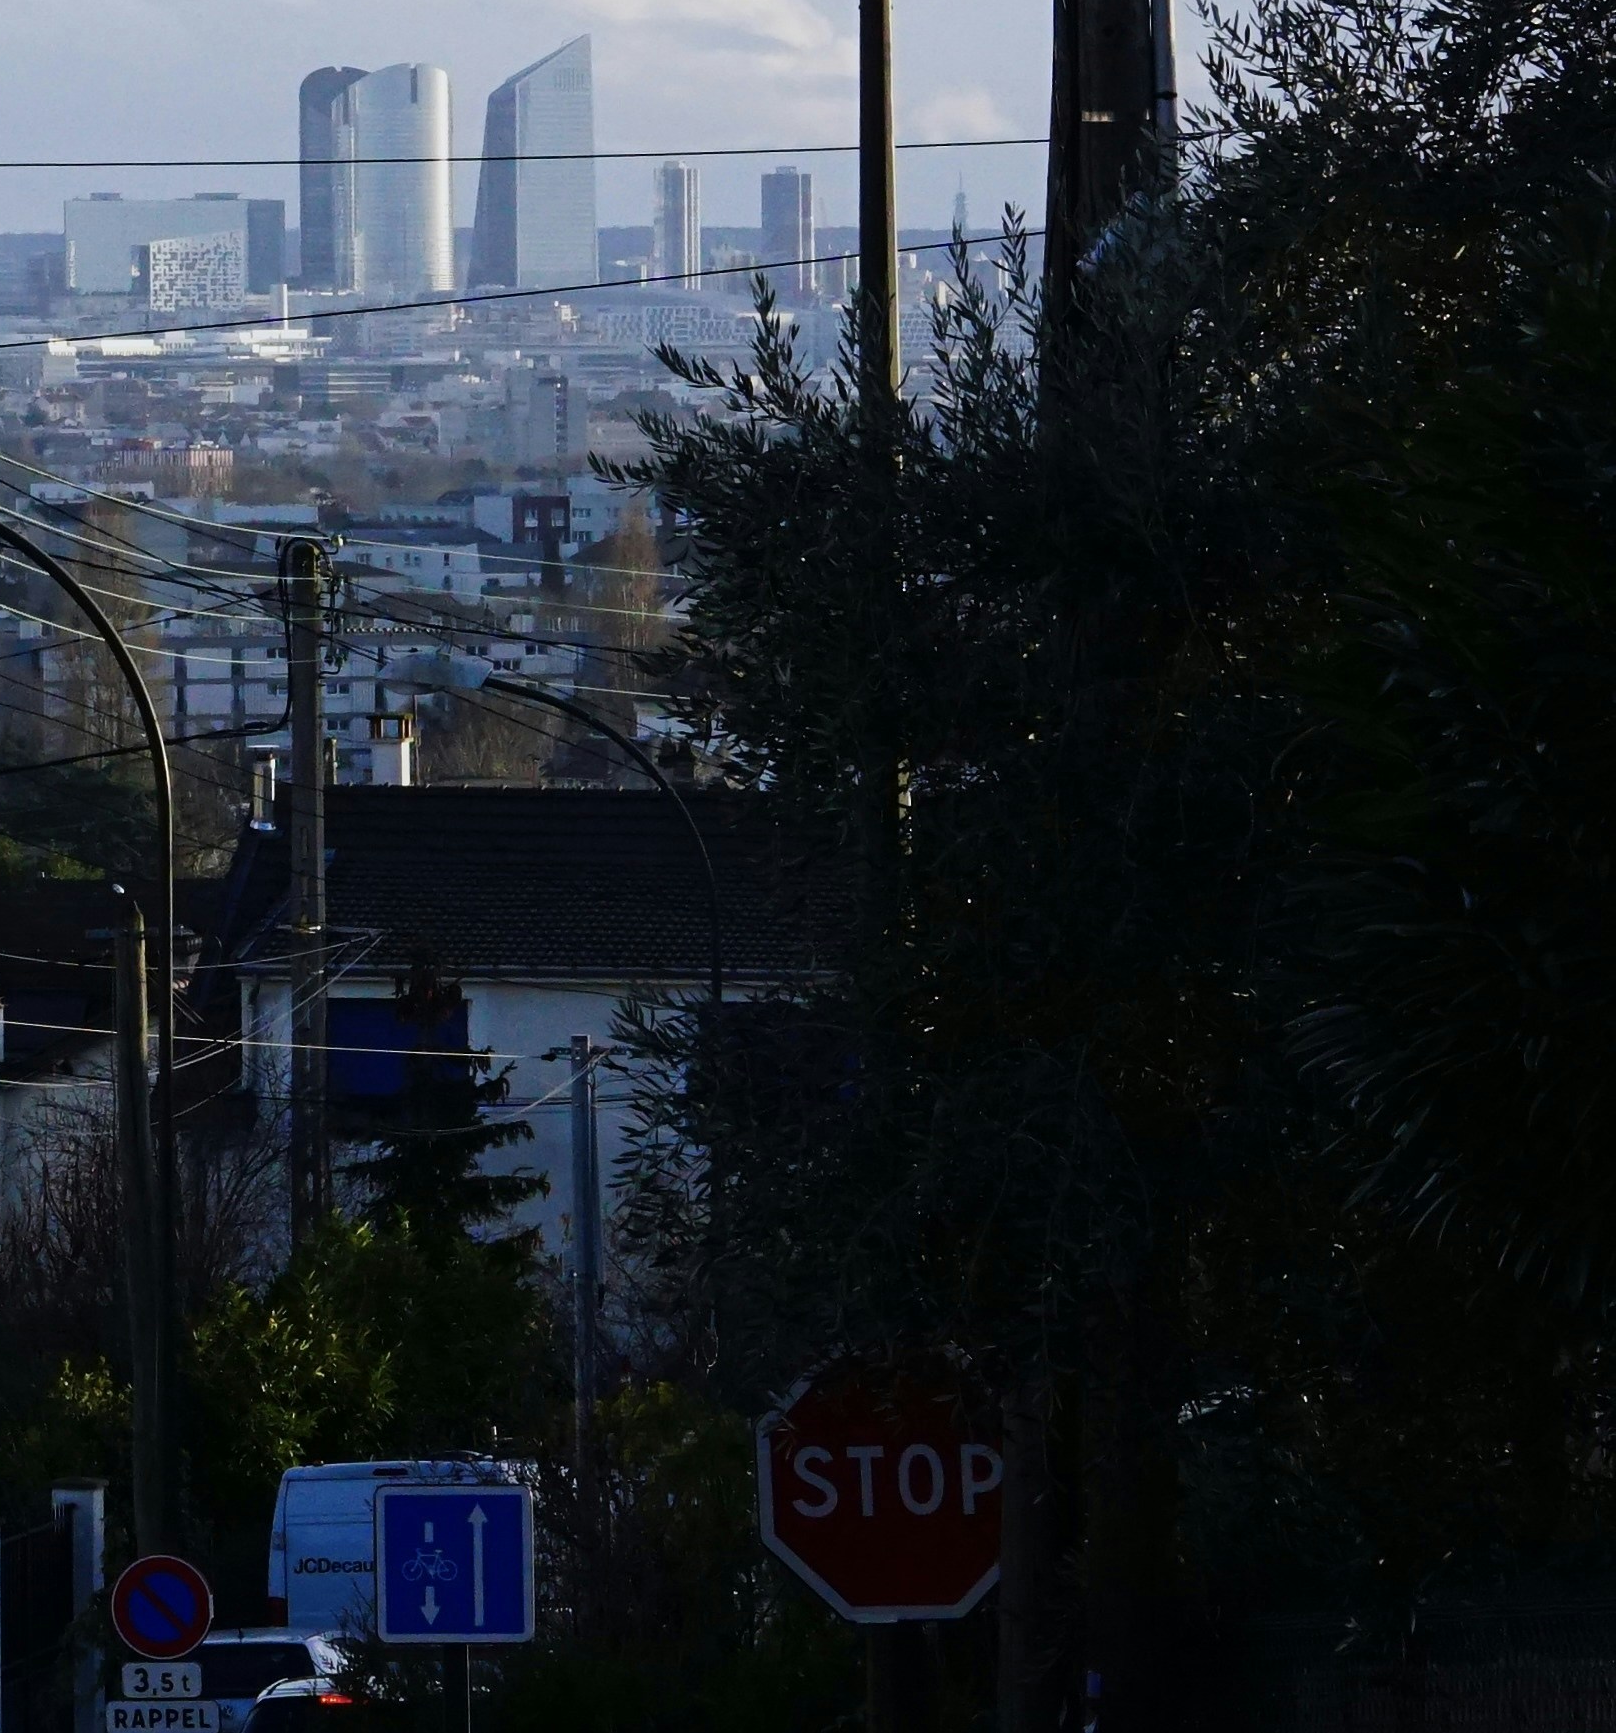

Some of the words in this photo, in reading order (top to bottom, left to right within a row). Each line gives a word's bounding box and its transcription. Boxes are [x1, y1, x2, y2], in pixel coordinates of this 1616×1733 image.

[791, 1443, 1004, 1518] STOP
[294, 1557, 374, 1574] JCDecau
[134, 1668, 174, 1696] 3,5
[182, 1675, 190, 1692] t
[114, 1708, 211, 1728] RAPPEL
